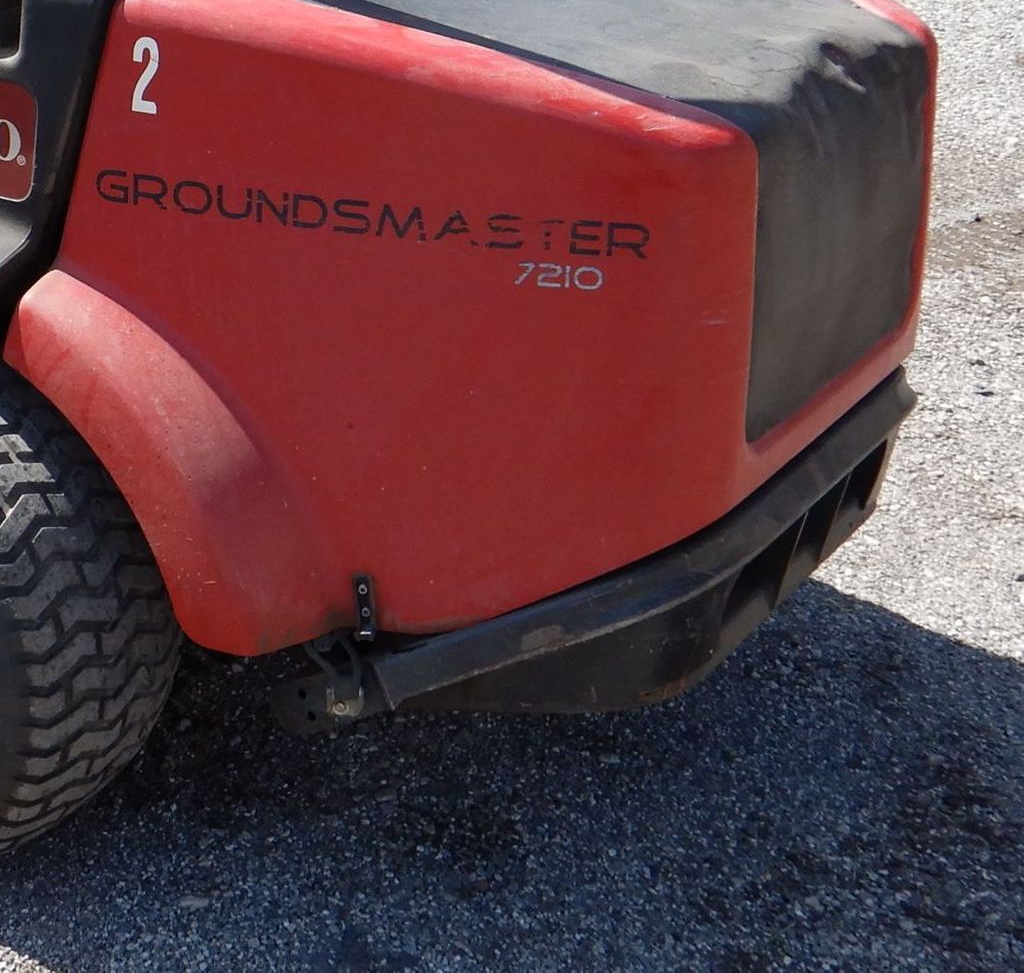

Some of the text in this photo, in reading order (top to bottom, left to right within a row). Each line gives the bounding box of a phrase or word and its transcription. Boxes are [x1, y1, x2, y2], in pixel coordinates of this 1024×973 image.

[131, 36, 160, 115] 2
[95, 168, 651, 259] GROUNDSMASTER
[514, 262, 605, 291] 7210
